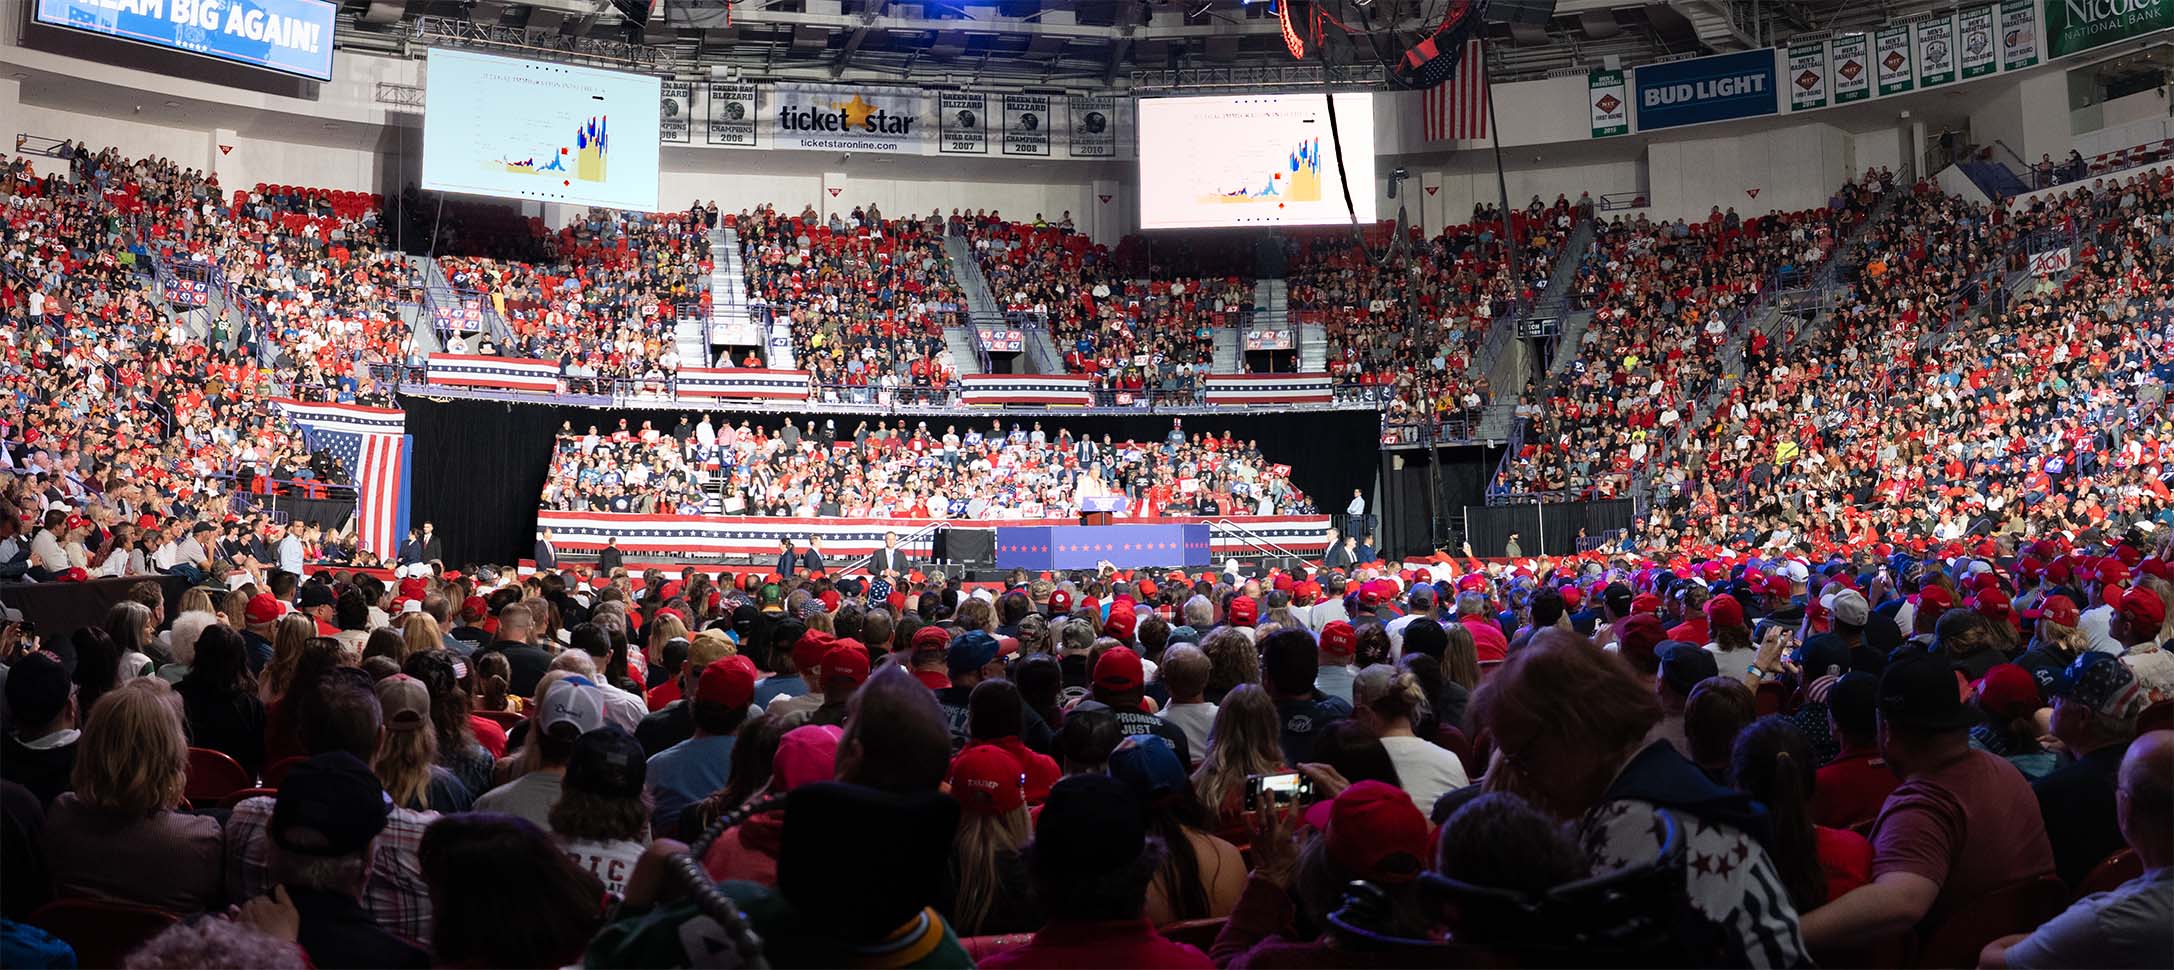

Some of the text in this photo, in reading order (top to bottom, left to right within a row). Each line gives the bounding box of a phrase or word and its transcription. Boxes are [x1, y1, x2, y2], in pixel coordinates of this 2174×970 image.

[171, 0, 219, 31] BIG
[224, 4, 321, 53] AGAIN!
[2063, 8, 2162, 40] NATIONAL BANK
[1920, 32, 1951, 43] BASKETBALL
[1879, 41, 1908, 51] BASKETBALL
[1791, 61, 1823, 70] BASKETBALL
[661, 90, 688, 98] ZZARD
[1645, 73, 1766, 107] BUD LIGHT
[712, 92, 753, 101] BLIZZARD
[943, 93, 968, 101] GREEN
[1032, 96, 1046, 104] BAY
[943, 101, 983, 109] BLIZZARD
[1007, 103, 1047, 111] BLIZZARD
[780, 105, 914, 134] ticket star
[662, 123, 687, 131] PIONS
[711, 125, 753, 134] CHAMPIONS
[661, 131, 677, 139] 006
[720, 134, 743, 142] 2006
[801, 139, 898, 150] ticketstaronline.com
[953, 142, 975, 150] 2007
[1016, 144, 1038, 152] 2008
[194, 283, 206, 292] 47
[1537, 280, 1548, 289] 47
[194, 296, 206, 304] 47
[466, 322, 479, 330] 47
[994, 331, 1007, 340] 47
[1008, 332, 1021, 340] 47
[1249, 331, 1261, 339] 47
[1262, 331, 1276, 339] 47
[1008, 342, 1021, 350] 47
[1903, 342, 1916, 351] 47
[1384, 436, 1396, 444] 47
[2075, 438, 2092, 451] 47
[2046, 461, 2064, 471] 47
[1275, 466, 1288, 476] 47
[949, 502, 966, 512] 47
[1333, 635, 1348, 644] USA
[1115, 711, 1165, 727] PROMISE
[1121, 724, 1152, 736] JUST
[967, 779, 999, 790] TRUMP
